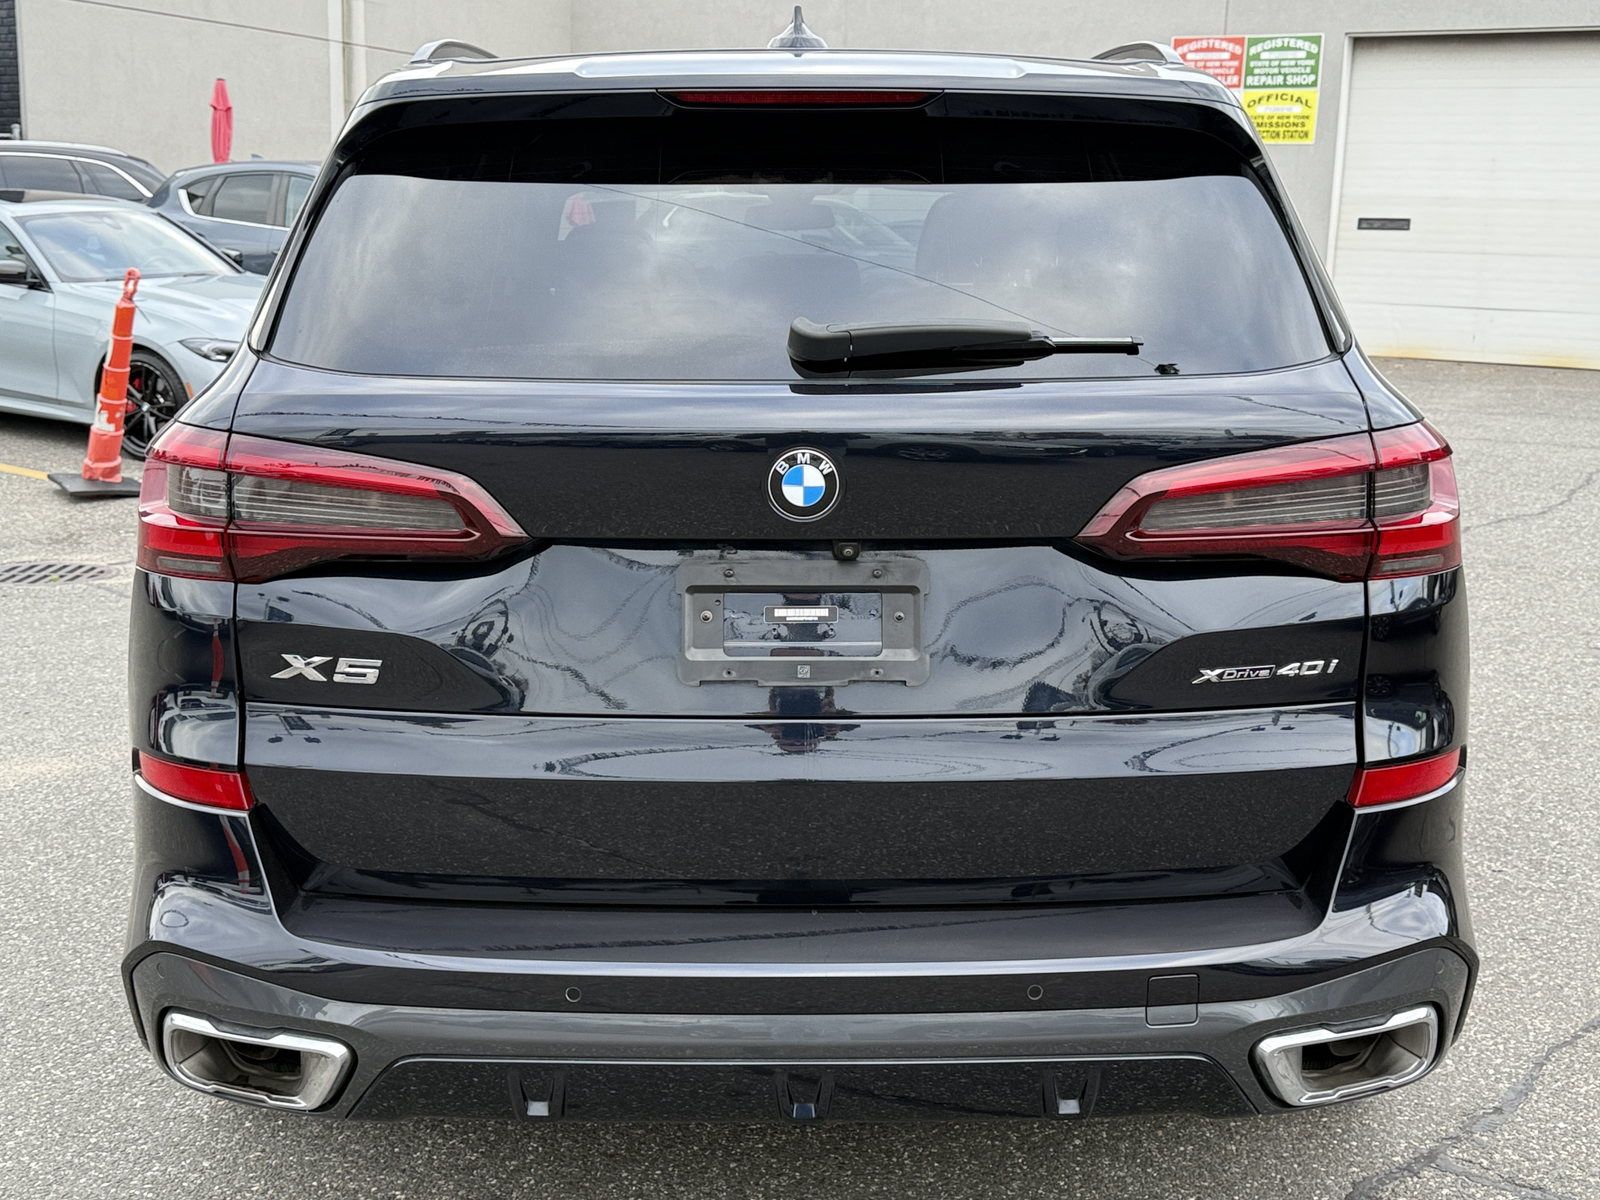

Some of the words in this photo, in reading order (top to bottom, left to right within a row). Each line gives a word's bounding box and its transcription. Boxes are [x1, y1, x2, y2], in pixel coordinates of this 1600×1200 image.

[1176, 38, 1242, 55] REGISTERED
[1249, 37, 1319, 56] REGISTERED
[1280, 66, 1311, 74] VEHICLE
[1217, 76, 1239, 85] ALER
[1246, 75, 1284, 86] REPAIR
[1285, 74, 1316, 85] SHOP
[1247, 93, 1312, 108] OFFICIAL
[1282, 130, 1309, 139] STATION
[775, 452, 833, 476] BMW
[270, 653, 383, 685] X5
[1276, 659, 1339, 677] 40i
